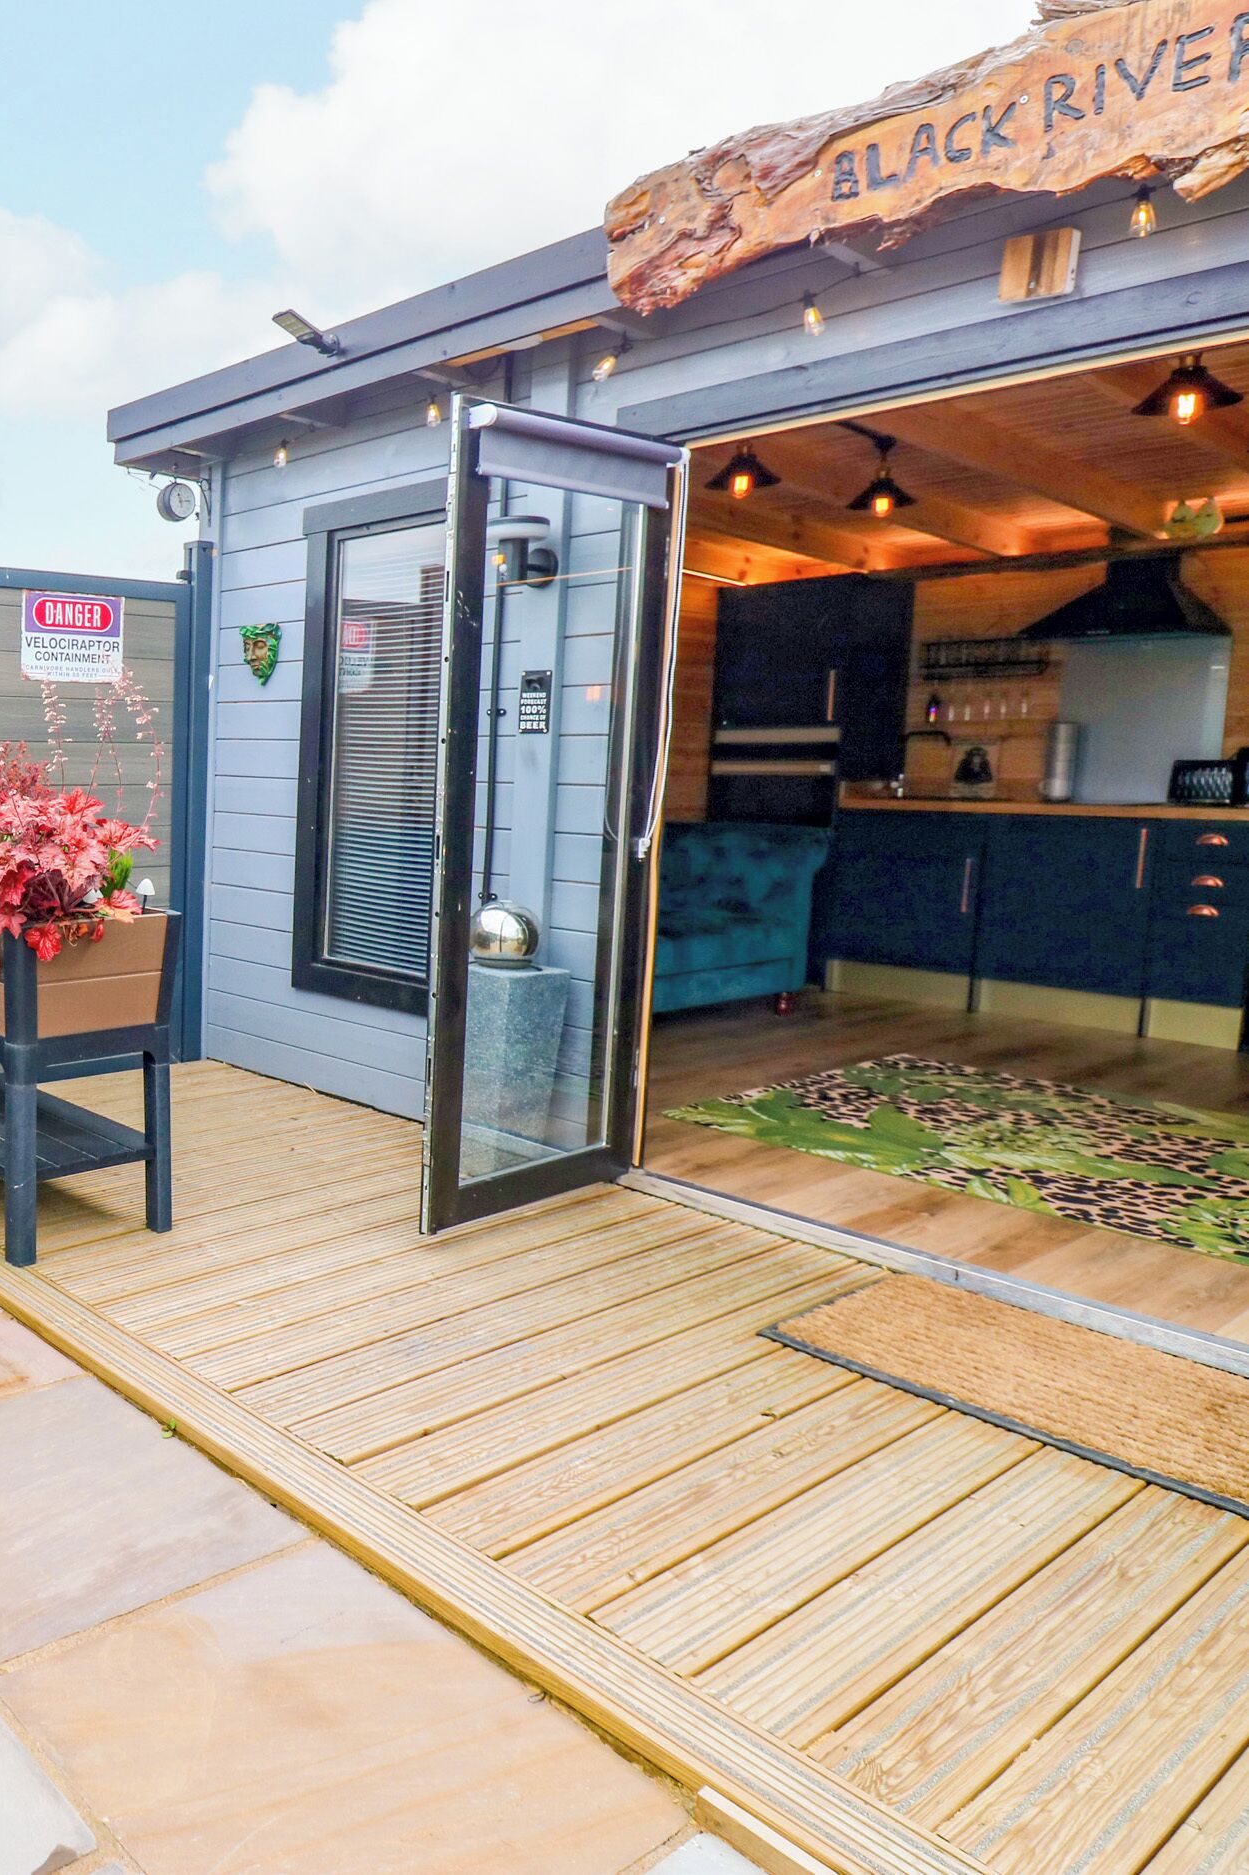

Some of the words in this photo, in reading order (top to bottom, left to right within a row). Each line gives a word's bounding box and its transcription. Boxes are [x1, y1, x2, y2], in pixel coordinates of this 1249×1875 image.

[832, 102, 1016, 202] BLACK
[45, 601, 101, 628] DANGER
[25, 636, 120, 653] VELOCIRAPTOR
[34, 650, 112, 665] CONTAINMENT
[520, 705, 547, 714] 100%
[519, 721, 546, 729] BEER
